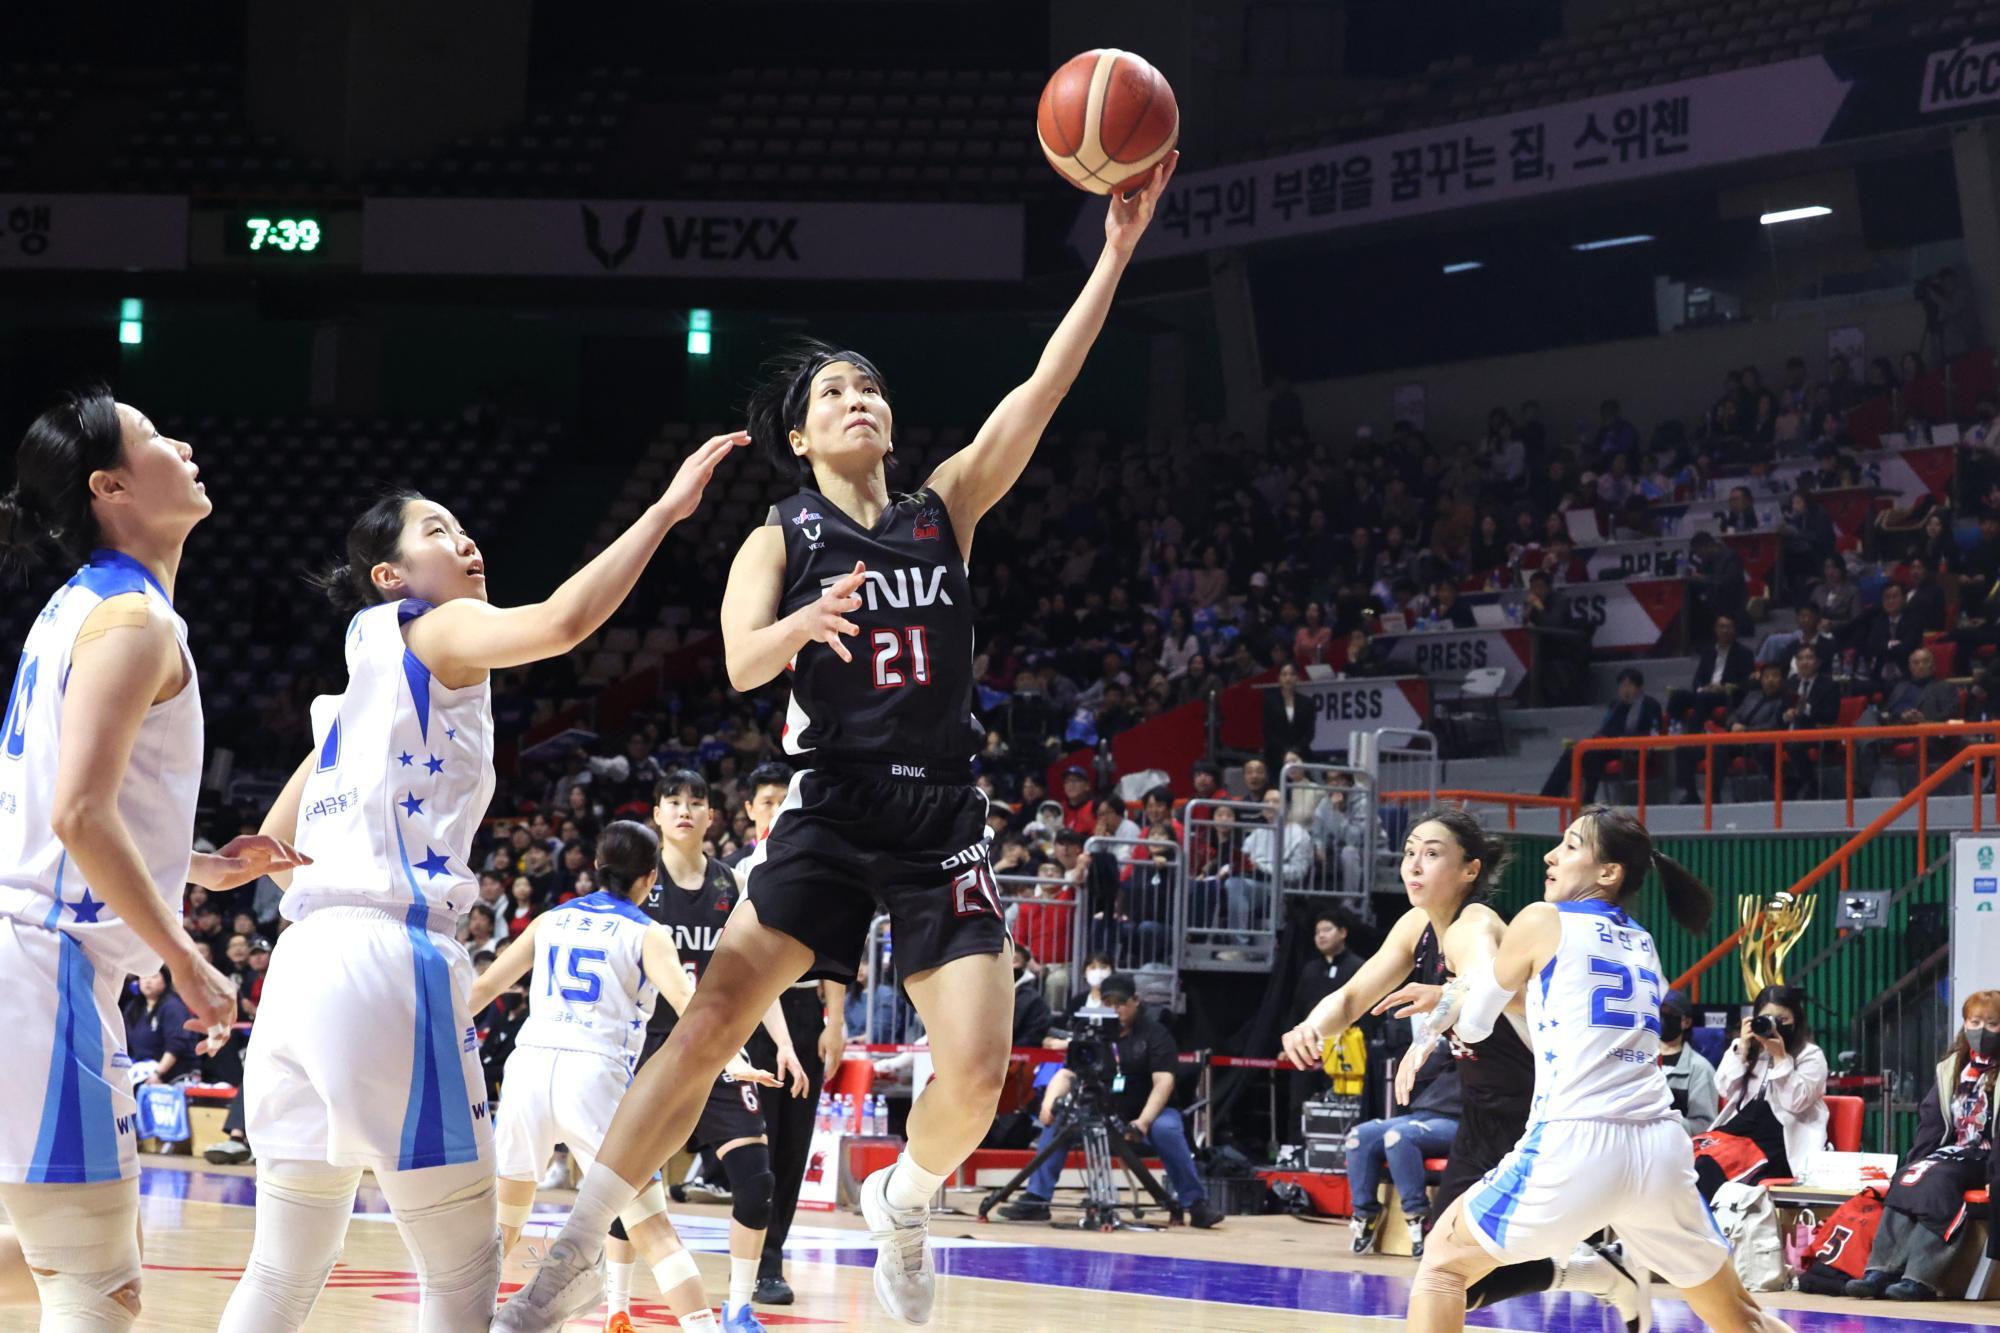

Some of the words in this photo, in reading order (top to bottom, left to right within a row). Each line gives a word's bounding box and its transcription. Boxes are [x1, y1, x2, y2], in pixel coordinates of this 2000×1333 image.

[1161, 177, 1256, 238] 식구의
[1272, 155, 1371, 221] 부활을
[1391, 136, 1495, 202] 꿈꾸는
[1510, 123, 1555, 182] 집,
[1573, 96, 1690, 169] 스위첸
[247, 218, 320, 251] 7:39
[663, 216, 800, 261] VEXX
[870, 625, 931, 688] 21
[1416, 639, 1488, 672] PRESS
[1313, 689, 1383, 720] PRESS
[891, 764, 926, 778] BNK
[547, 945, 608, 1004] 15
[1587, 954, 1662, 1038] 23
[739, 1083, 760, 1113] 6
